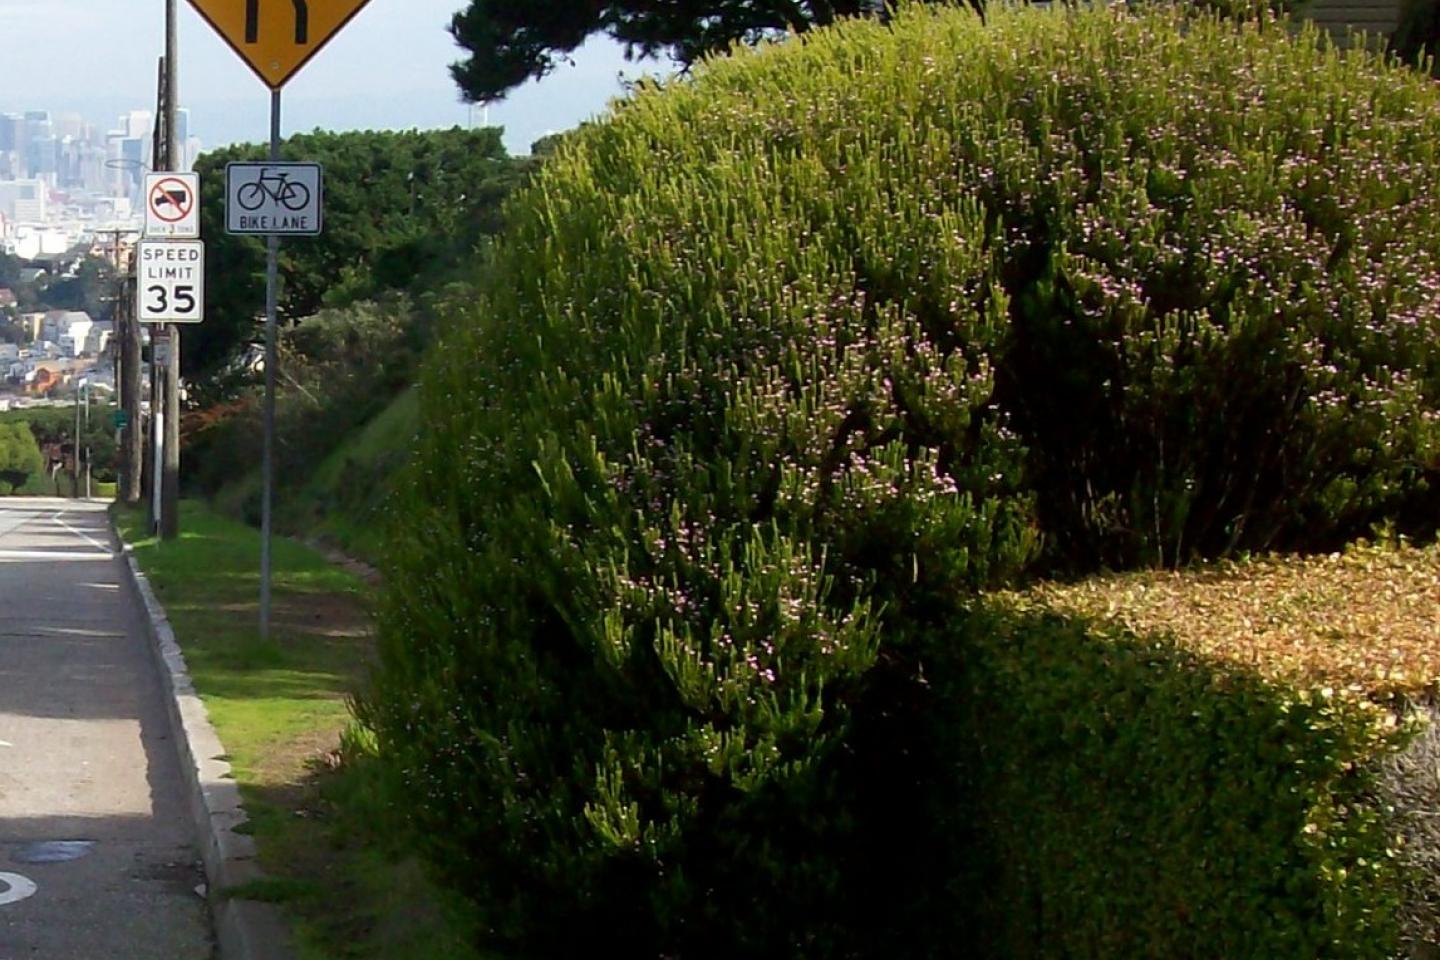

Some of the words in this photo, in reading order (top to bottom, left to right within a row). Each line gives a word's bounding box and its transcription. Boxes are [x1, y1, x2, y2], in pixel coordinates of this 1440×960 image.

[240, 216, 266, 229] BIKE
[272, 216, 308, 229] LANE
[143, 248, 199, 261] SPEED
[148, 267, 193, 279] LIMIT
[146, 285, 195, 314] 35
